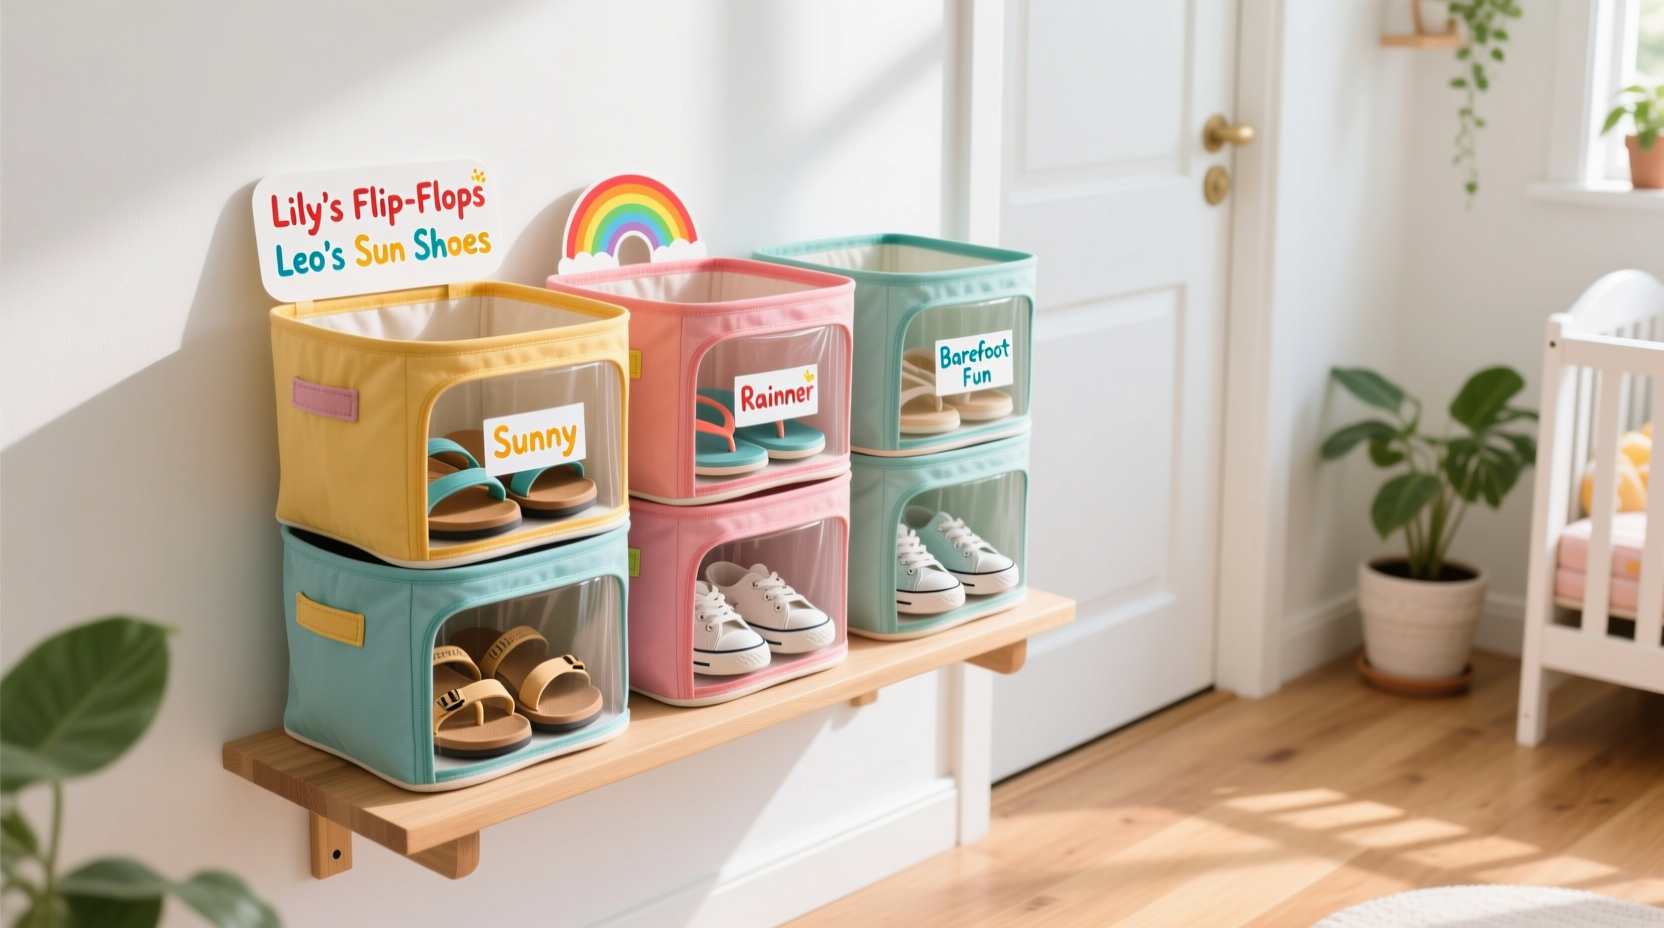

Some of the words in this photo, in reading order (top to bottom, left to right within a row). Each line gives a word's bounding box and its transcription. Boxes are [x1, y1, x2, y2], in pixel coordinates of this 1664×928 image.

[271, 191, 344, 236] Lily's
[353, 180, 486, 226] Flip-Flops
[276, 240, 346, 277] Leo's
[354, 234, 405, 267] Sun
[413, 227, 492, 261] Shoes
[940, 338, 1010, 369] Barefoot
[963, 367, 991, 387] Fun
[741, 385, 814, 412] Rainner
[493, 425, 577, 458] Sunny
